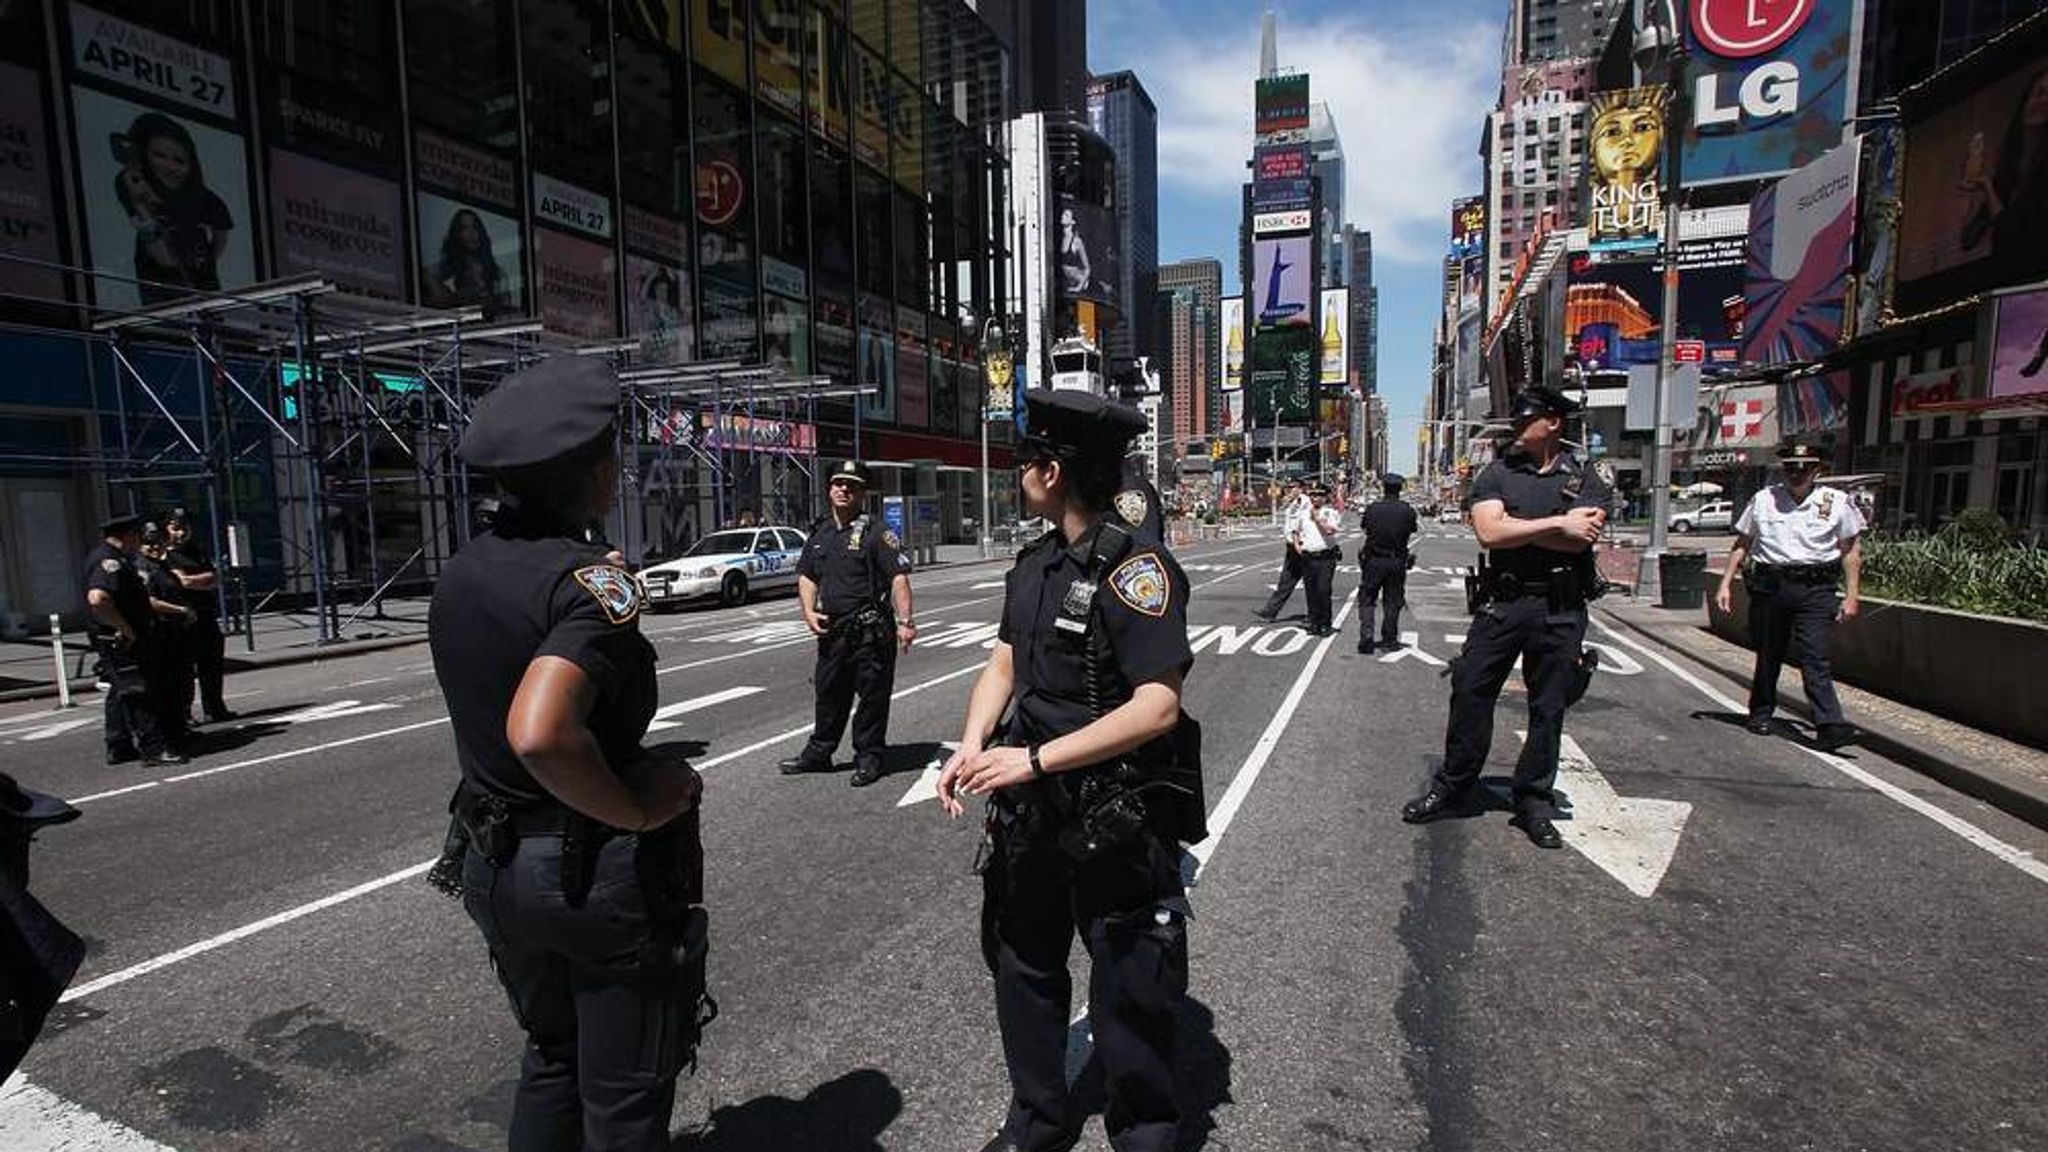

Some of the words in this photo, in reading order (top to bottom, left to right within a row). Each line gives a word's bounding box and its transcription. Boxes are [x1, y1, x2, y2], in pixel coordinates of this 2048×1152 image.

[95, 19, 216, 76] AVAILABLE
[83, 39, 182, 92] APRIL
[190, 75, 225, 105] 27
[1694, 61, 1800, 129] LG
[1592, 180, 1658, 207] KING
[285, 197, 392, 238] miranda
[541, 196, 584, 225] APRIL
[587, 213, 604, 231] 27
[1256, 214, 1290, 230] HSBC
[1592, 203, 1652, 231] TUT
